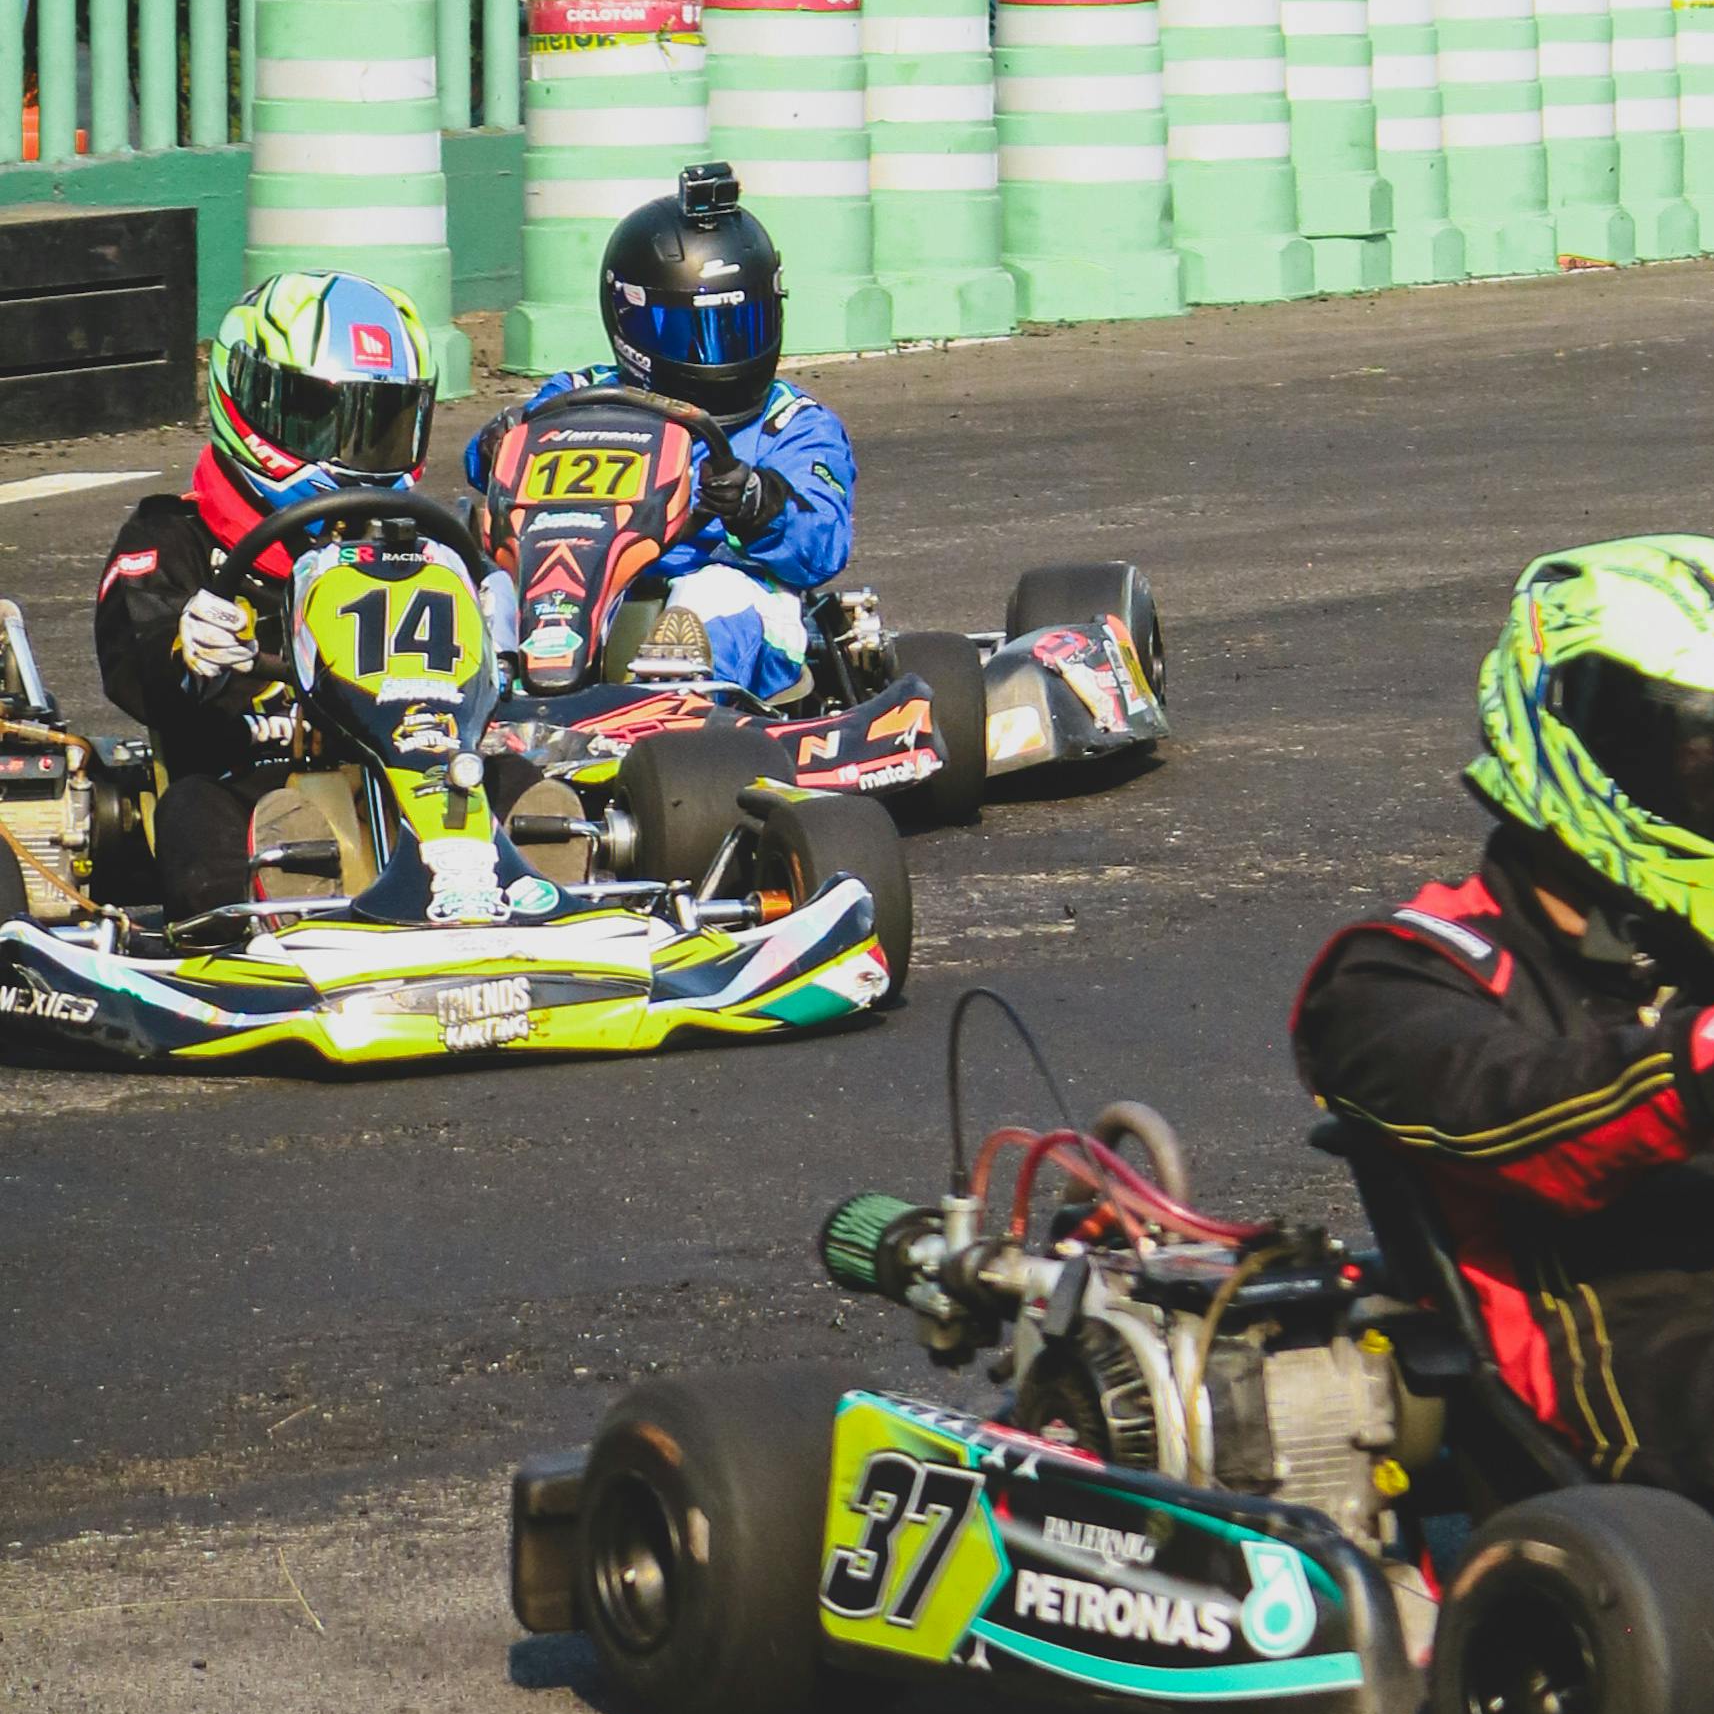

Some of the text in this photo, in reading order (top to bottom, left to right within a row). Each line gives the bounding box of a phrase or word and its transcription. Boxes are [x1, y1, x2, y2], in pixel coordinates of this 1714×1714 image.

[566, 6, 646, 22] CICLOTÓN
[243, 433, 297, 470] MT
[537, 455, 634, 496] 127
[339, 546, 374, 563] SR
[336, 586, 463, 679] 14
[437, 976, 531, 1026] FRIENDS
[818, 1450, 987, 1629] 37
[1014, 1569, 1232, 1653] PETRONAS
